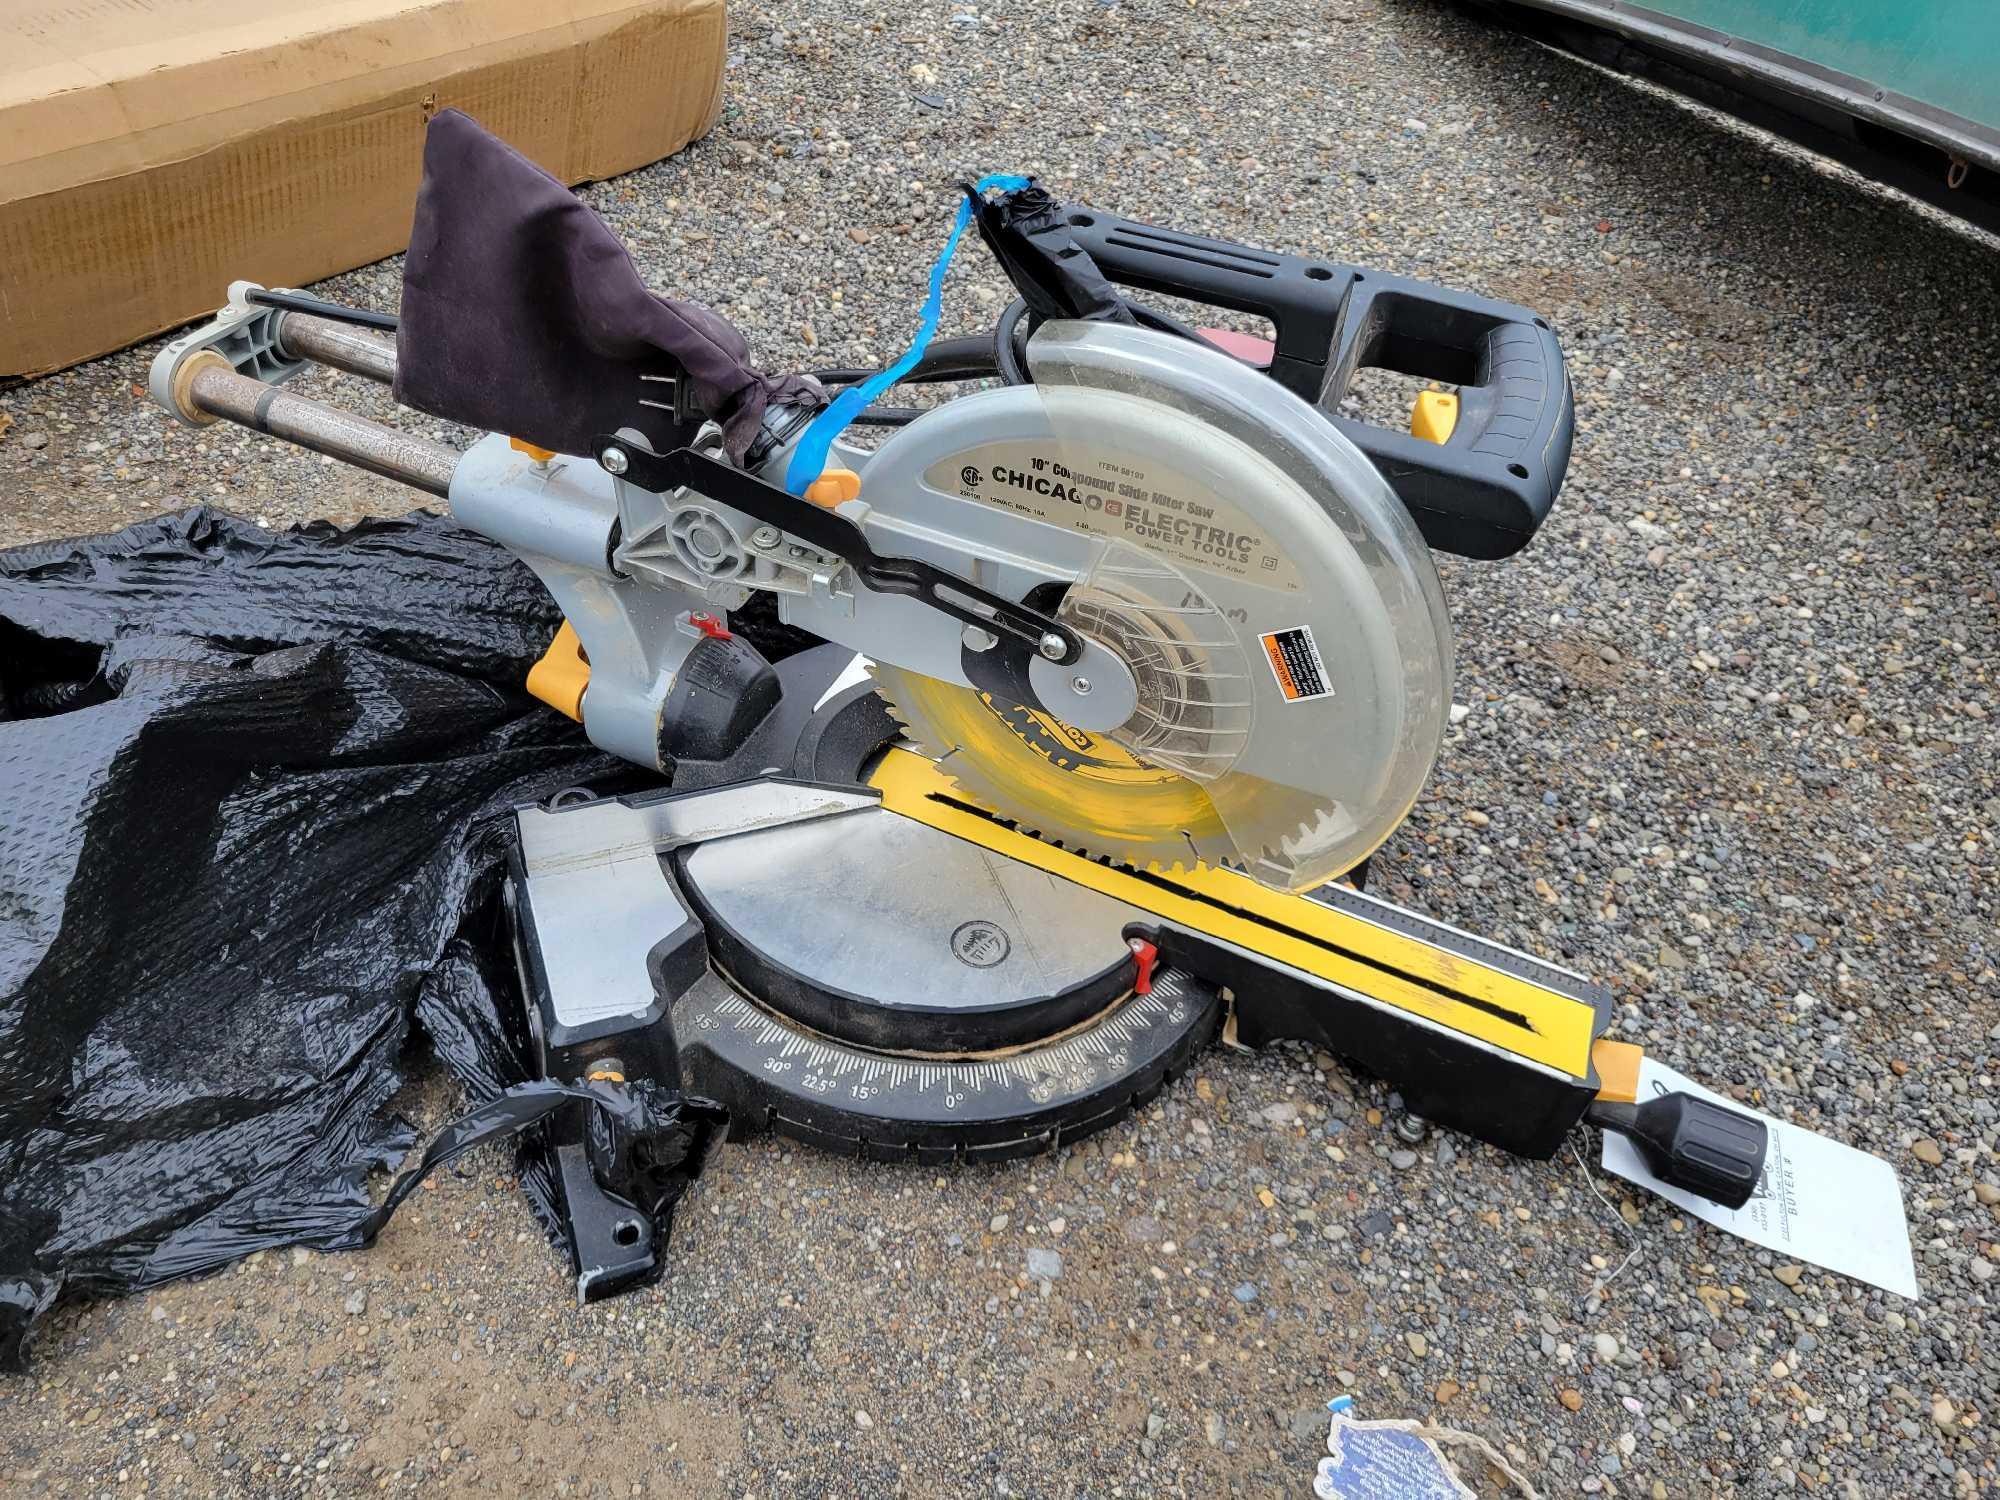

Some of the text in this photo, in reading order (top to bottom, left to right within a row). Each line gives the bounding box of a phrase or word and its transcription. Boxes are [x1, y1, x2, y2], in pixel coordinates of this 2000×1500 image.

[1098, 462, 1119, 473] ITEM
[991, 465, 1103, 511] CHICAGO
[1118, 483, 1148, 501] Slide
[1187, 501, 1214, 519] Saw
[1125, 521, 1184, 546] POWER
[1191, 540, 1249, 564] TOOLS
[1270, 648, 1290, 683] WARNING
[695, 1013, 720, 1030] 45°
[1167, 1001, 1184, 1025] 45°
[763, 1057, 792, 1073] 30°
[1107, 1047, 1128, 1070] 30°
[801, 1074, 837, 1093] 22.5°
[851, 1085, 879, 1101] 15°
[1029, 1079, 1055, 1100] 15°
[945, 1092, 964, 1109] 0°
[1784, 1169, 1798, 1216] BUYER
